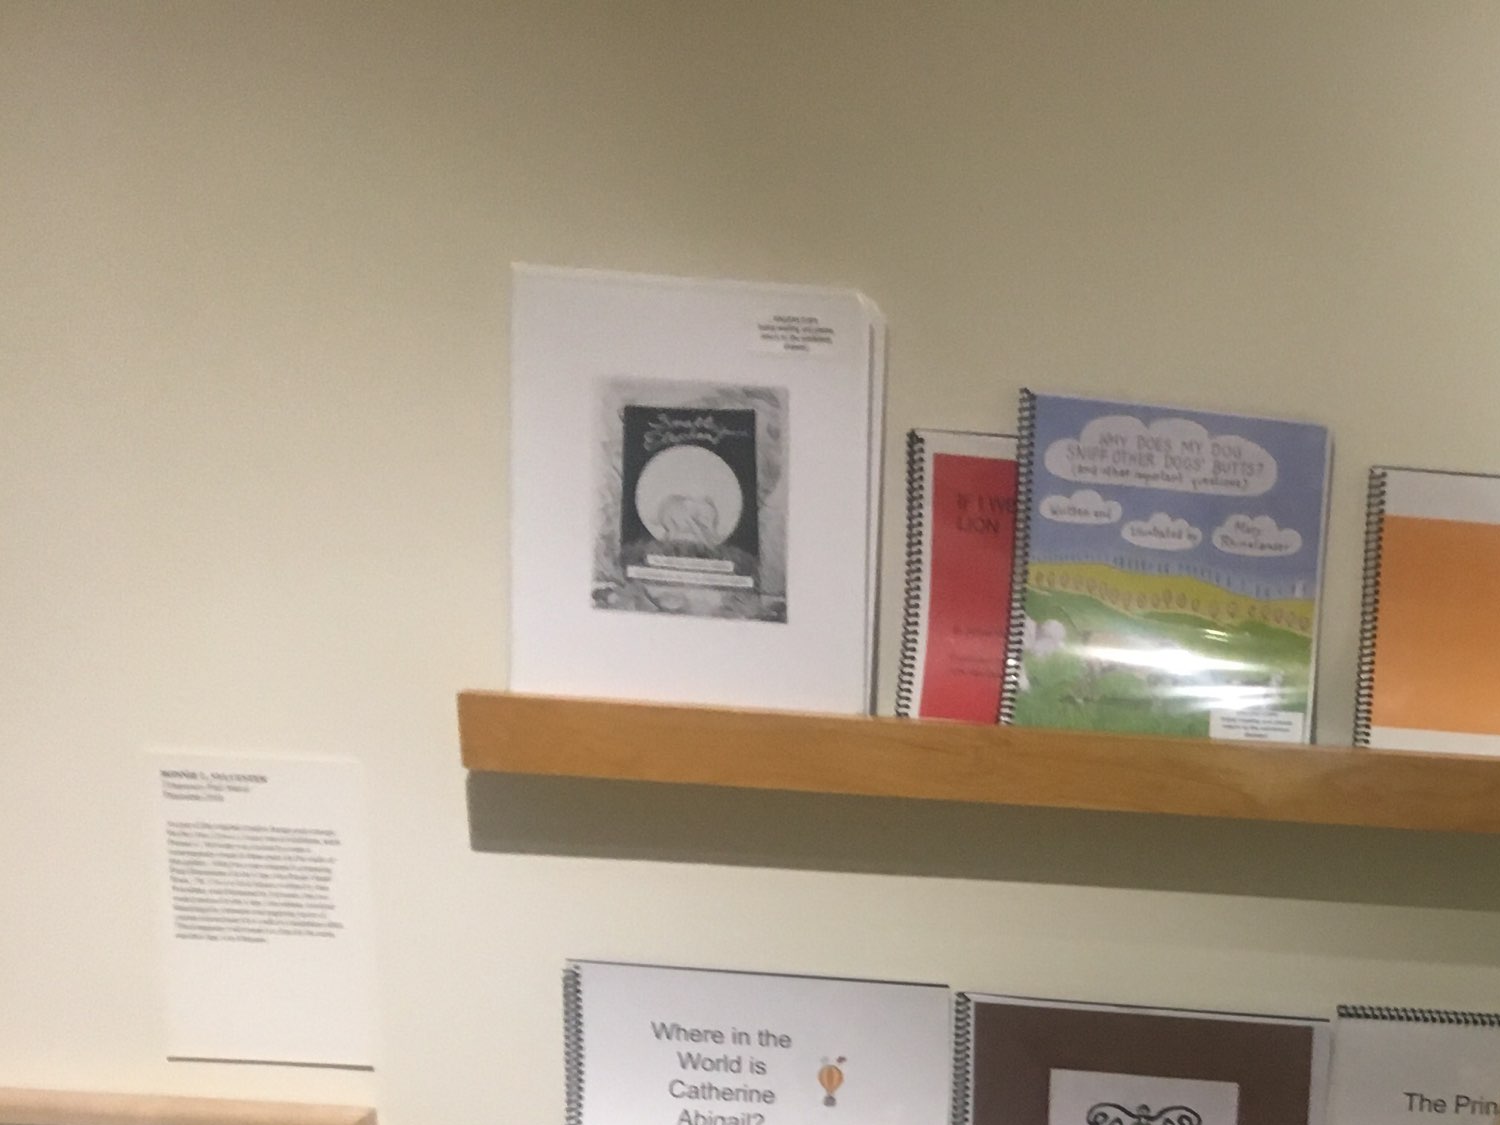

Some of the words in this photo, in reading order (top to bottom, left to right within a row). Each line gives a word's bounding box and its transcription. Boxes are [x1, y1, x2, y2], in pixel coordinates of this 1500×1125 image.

[1099, 430, 1128, 448] WHY
[1136, 434, 1173, 452] DOES
[1180, 438, 1204, 455] MY
[1210, 441, 1243, 459] DOG
[1111, 447, 1156, 467] OTHER
[957, 515, 1000, 534] LION
[650, 1021, 725, 1045] Where
[731, 1027, 751, 1046] in
[757, 1029, 793, 1049] the
[677, 1051, 742, 1074] World
[749, 1056, 768, 1075] is
[668, 1078, 777, 1105] Catherine
[1403, 1091, 1447, 1114] The
